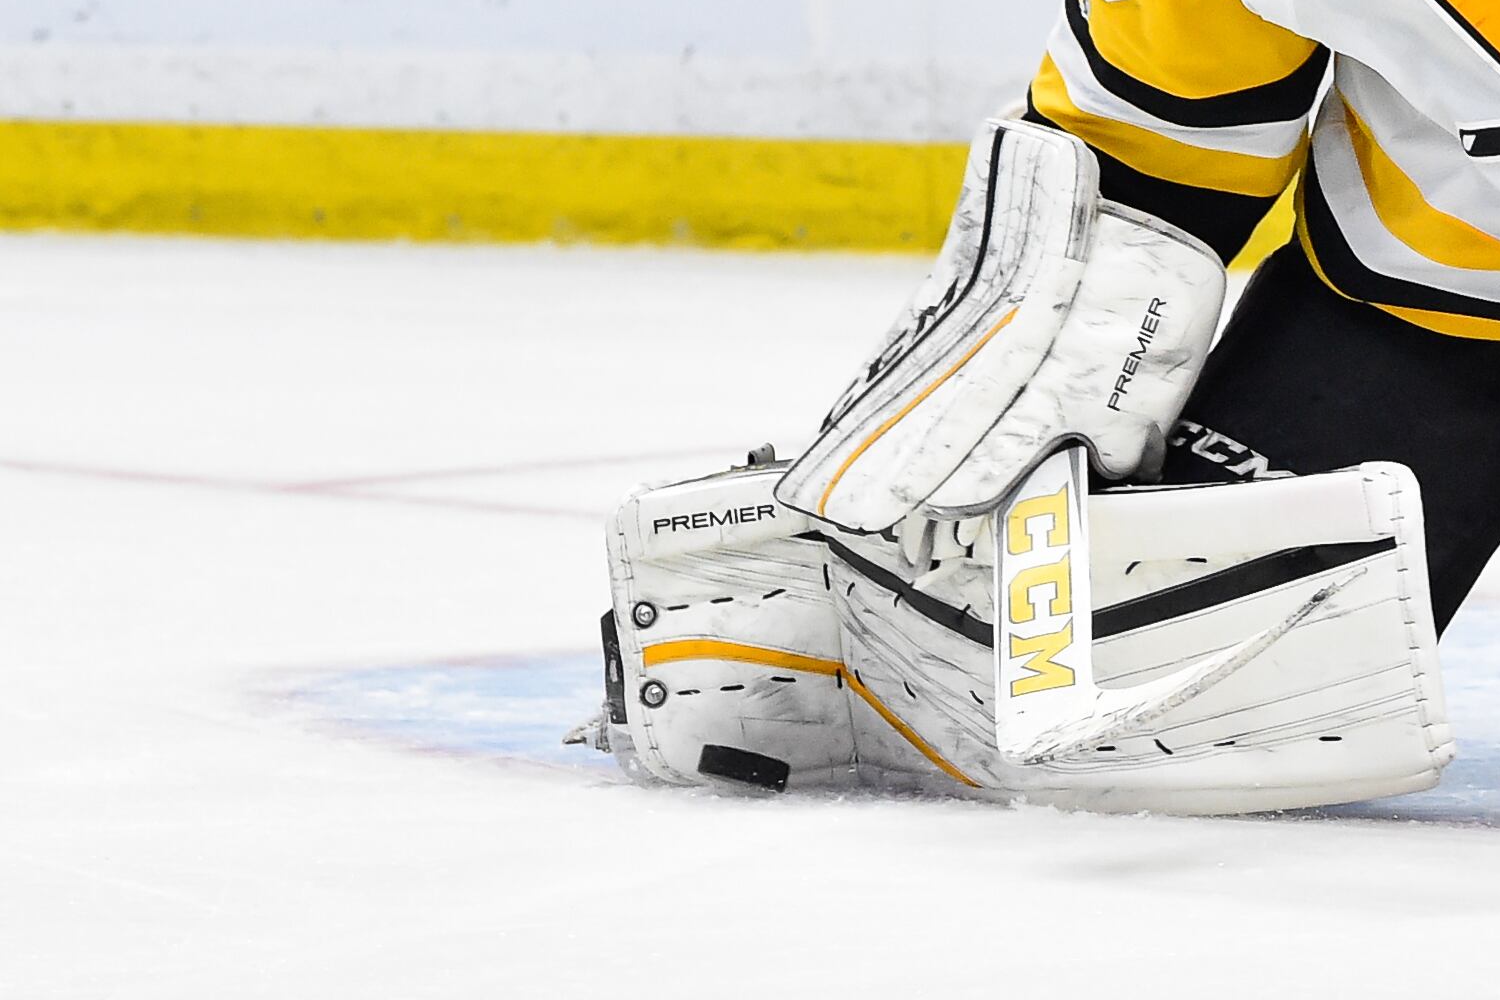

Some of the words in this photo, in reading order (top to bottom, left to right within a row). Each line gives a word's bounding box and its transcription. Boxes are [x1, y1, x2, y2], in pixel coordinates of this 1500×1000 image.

[1106, 296, 1168, 412] PREMIER
[652, 502, 777, 535] PREMIER
[1006, 480, 1077, 698] CCM
